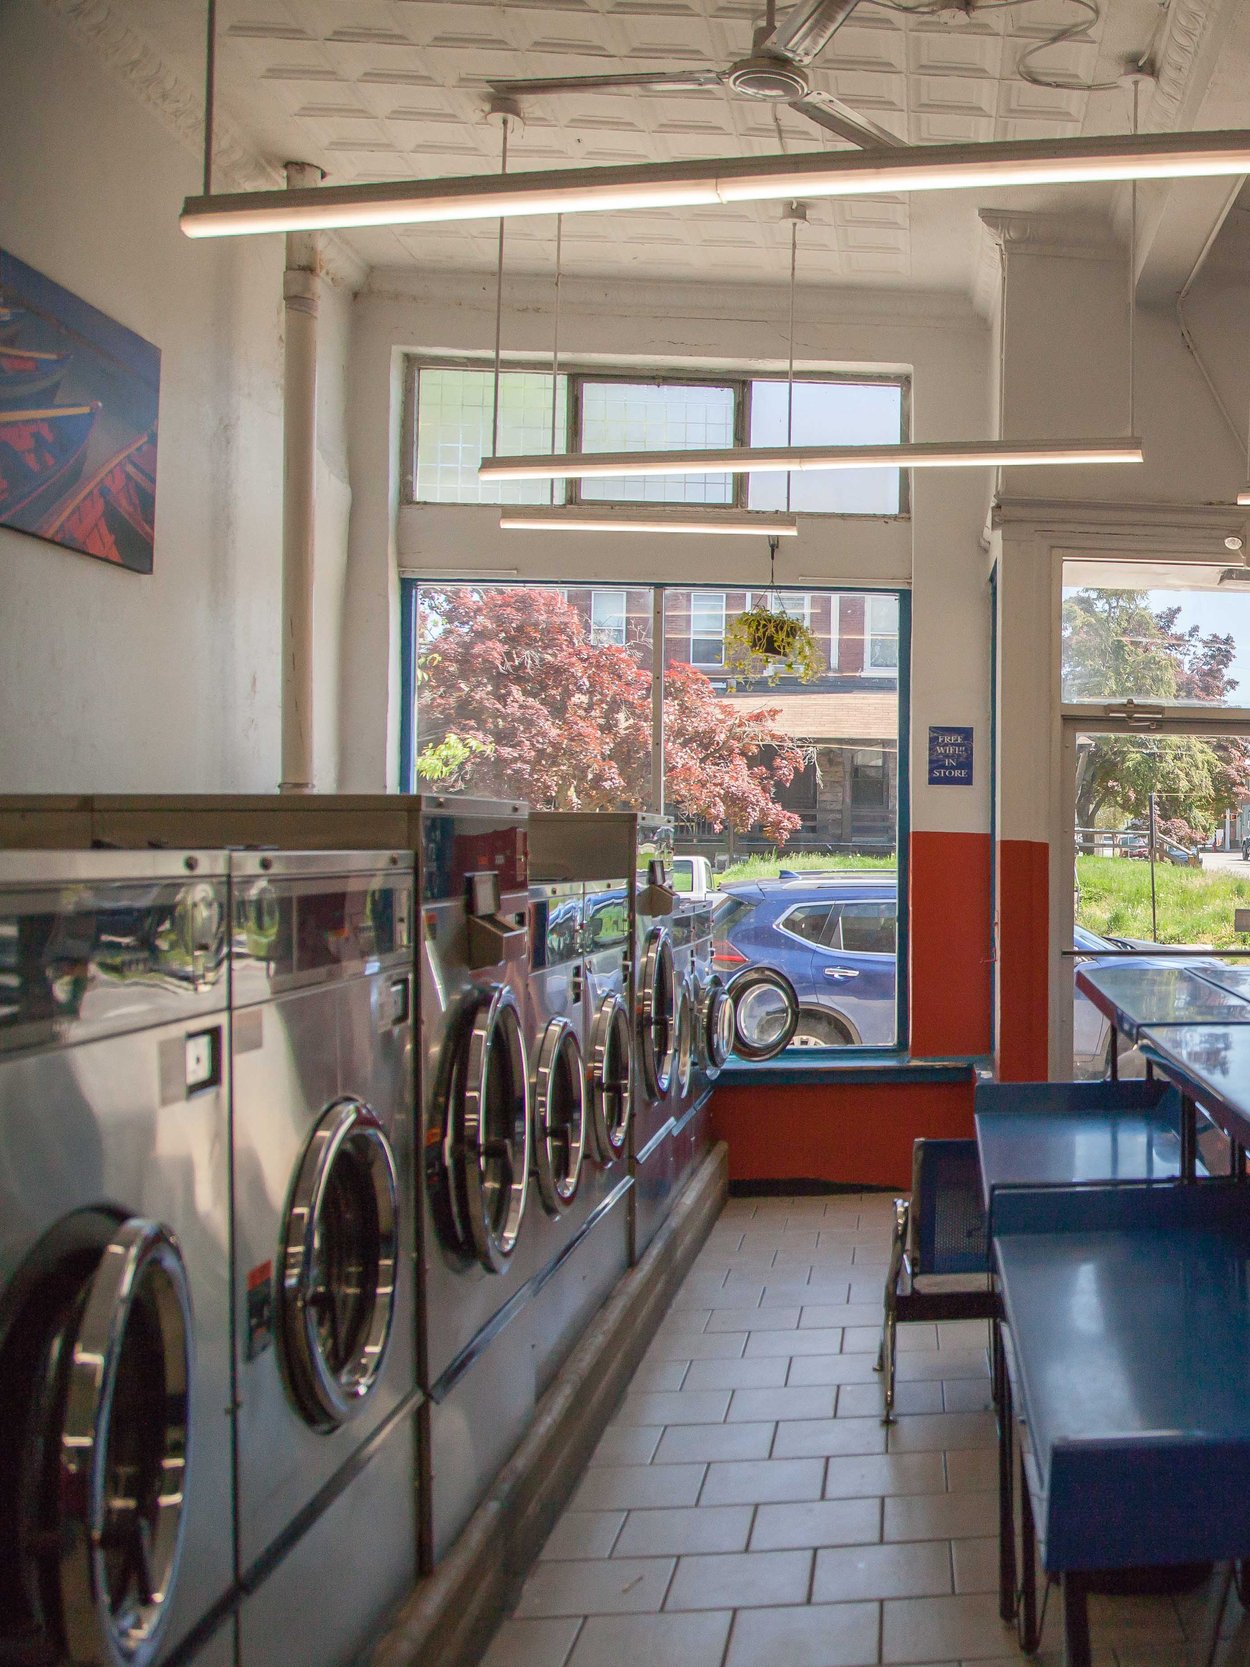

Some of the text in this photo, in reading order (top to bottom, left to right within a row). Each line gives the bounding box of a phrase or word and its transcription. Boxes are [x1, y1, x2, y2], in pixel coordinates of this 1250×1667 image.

[938, 735, 964, 743] FREE
[945, 758, 957, 767] IN
[933, 769, 968, 777] STORE
